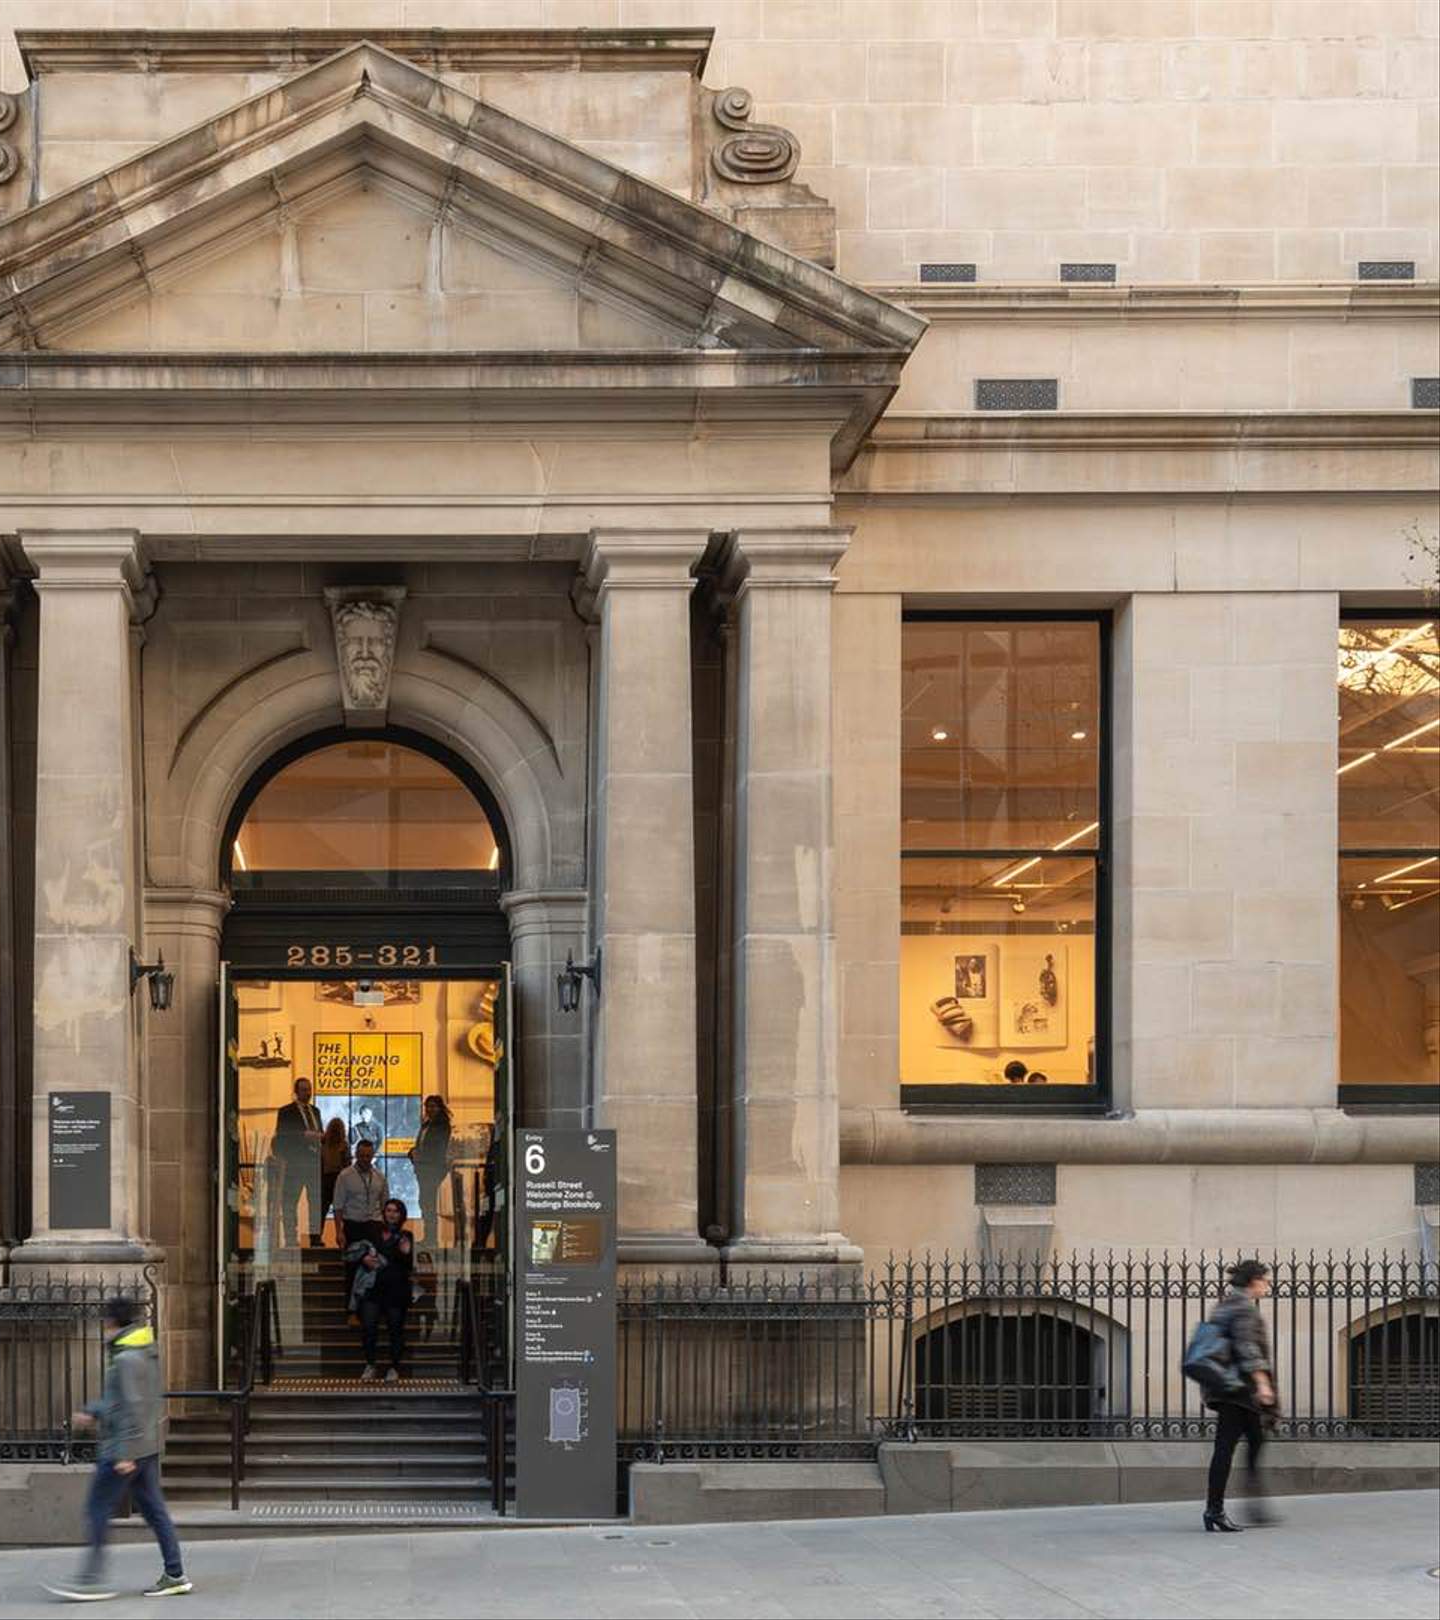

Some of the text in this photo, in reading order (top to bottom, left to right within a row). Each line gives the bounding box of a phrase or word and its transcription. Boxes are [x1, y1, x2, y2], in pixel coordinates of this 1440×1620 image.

[287, 945, 439, 967] 285-321
[317, 1043, 342, 1054] THE
[317, 1055, 400, 1066] CHANGING
[317, 1066, 376, 1078] FACE OF
[318, 1078, 385, 1089] VICTORIA
[525, 1133, 543, 1143] Entry
[525, 1144, 546, 1174] 6
[526, 1180, 583, 1189] Russell Street
[526, 1190, 585, 1199] Welcome Zone
[526, 1200, 602, 1211] Readings Bookshop
